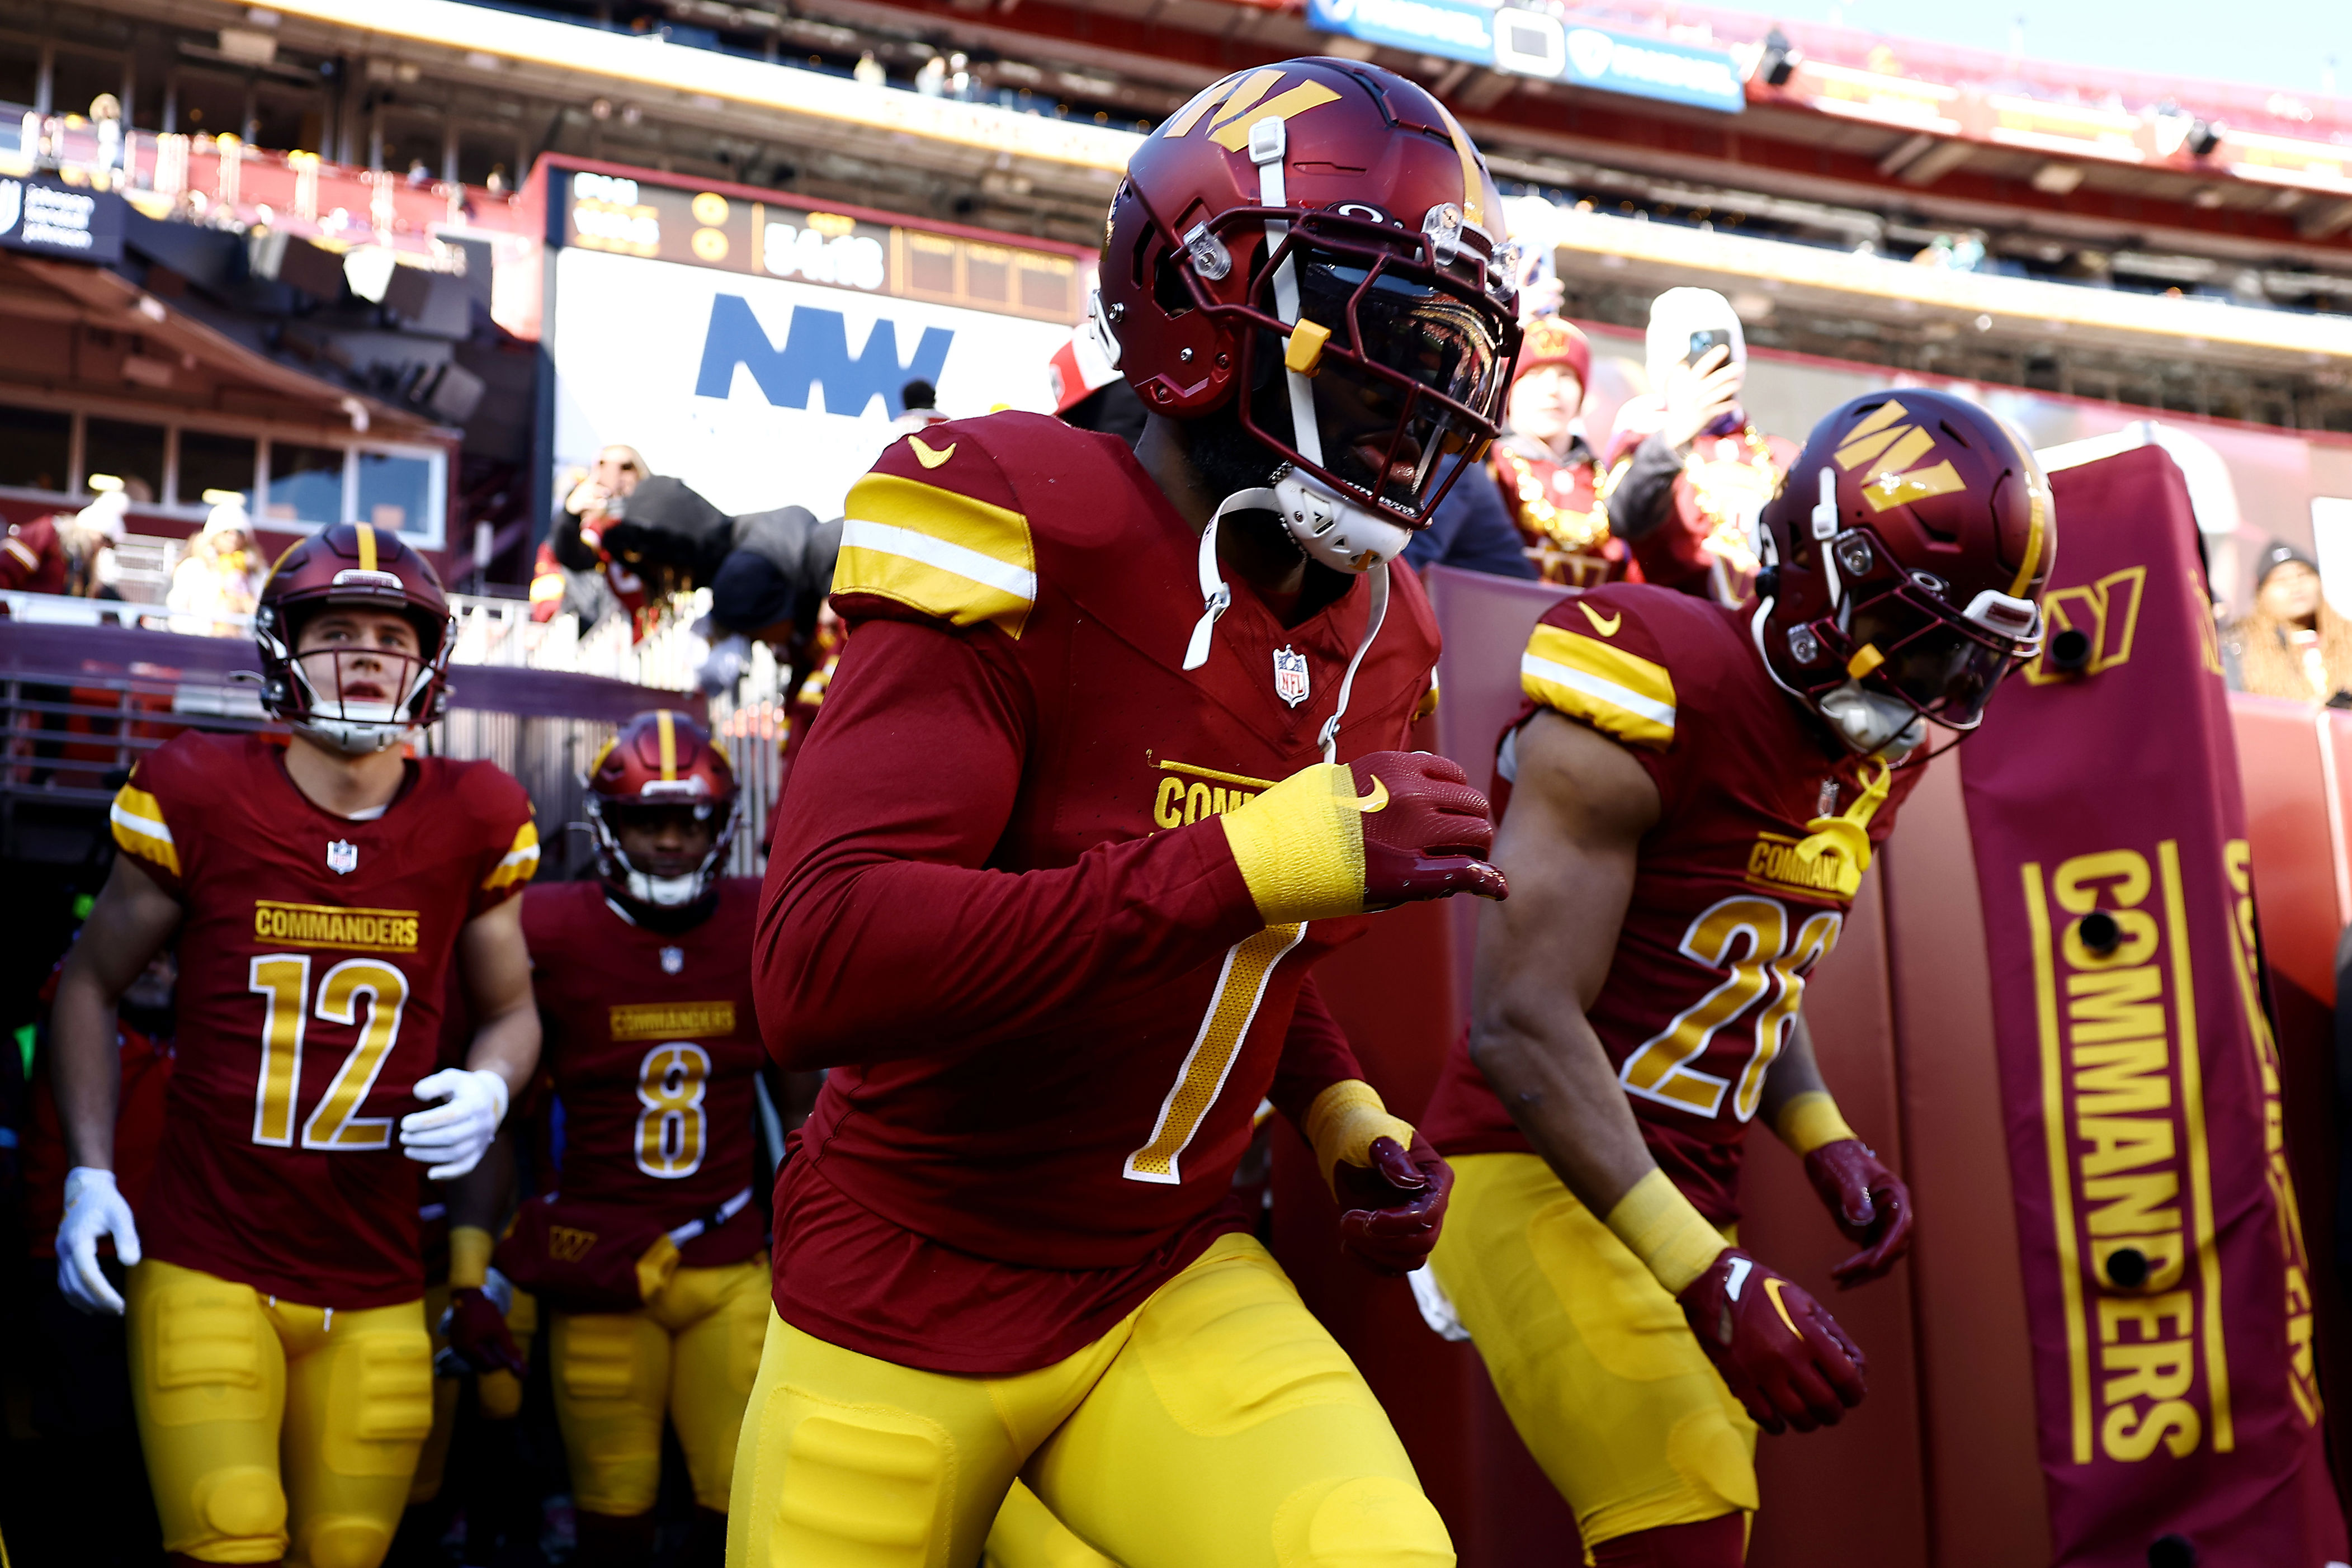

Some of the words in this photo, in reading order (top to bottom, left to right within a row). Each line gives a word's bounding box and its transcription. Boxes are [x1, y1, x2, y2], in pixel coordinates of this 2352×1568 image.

[695, 292, 956, 423] NW
[1279, 672, 1304, 695] NFL
[254, 906, 419, 947] COMMANDERS
[249, 952, 410, 1151] 12
[634, 1041, 712, 1179] 8
[2053, 848, 2202, 1462] COMMANDERS
